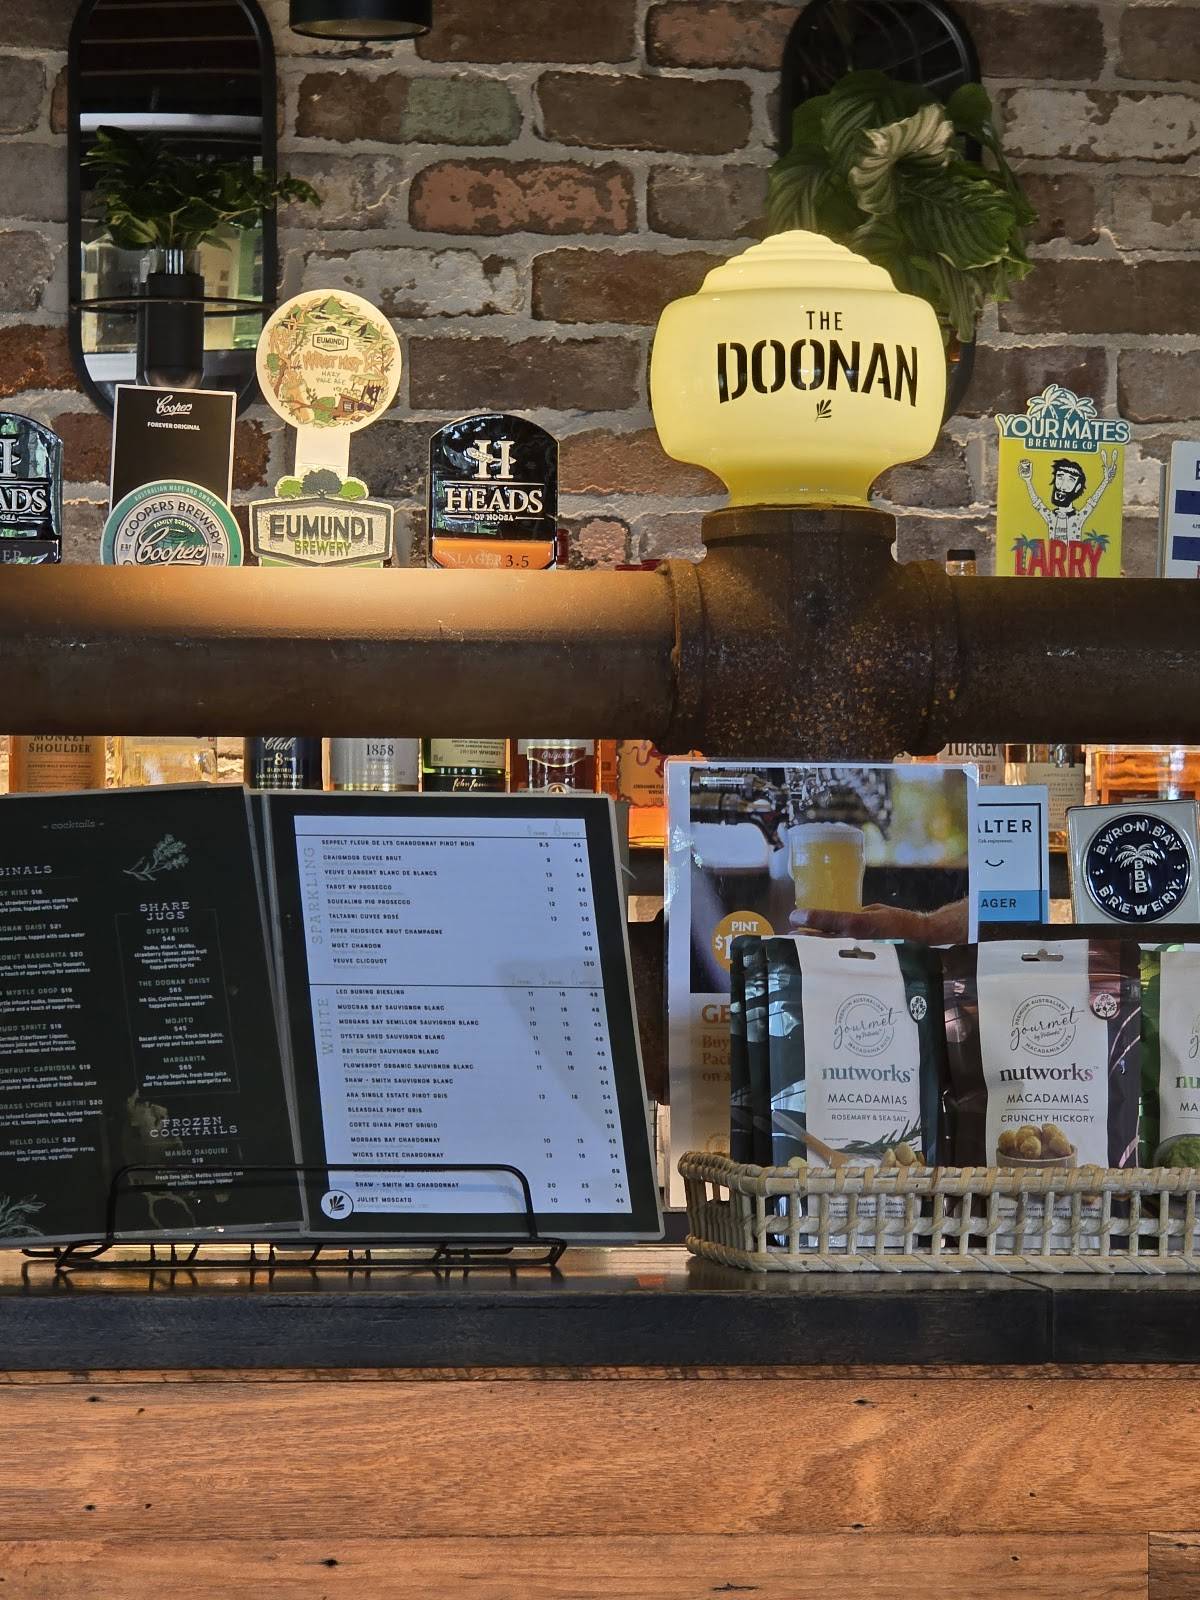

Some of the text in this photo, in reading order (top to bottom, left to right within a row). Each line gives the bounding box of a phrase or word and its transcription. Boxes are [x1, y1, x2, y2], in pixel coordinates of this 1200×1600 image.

[805, 310, 844, 331] THE
[316, 336, 345, 346] EUMUNDI
[717, 338, 918, 407] DOONAN
[156, 394, 193, 416] Coopers
[147, 421, 201, 431] FOREVER ORIGINAL
[999, 414, 1129, 442] YOUR MATES
[1027, 438, 1079, 449] BREWING
[169, 485, 185, 493] MADE
[185, 487, 198, 496] AND
[444, 487, 543, 513] HEADS
[125, 500, 223, 546] COOPERS BREWERY
[486, 514, 514, 522] NOOSA
[153, 518, 196, 533] FAMILY BREWED
[269, 513, 374, 545] EUMUNDI
[136, 526, 208, 566] Coopers
[294, 540, 352, 557] BREWERY
[505, 554, 530, 569] 3.5
[1014, 539, 1107, 578] LARRY
[28, 742, 91, 753] SHOULDER
[366, 743, 394, 756] 1858
[948, 742, 998, 757] TURKEY
[274, 752, 284, 766] 8
[50, 819, 96, 830] cocktails
[978, 819, 1032, 833] LTER
[1096, 819, 1182, 856] BYRON BAY
[304, 847, 323, 945] SPARKLING
[1098, 878, 1184, 916] BREWERY
[139, 901, 190, 912] SHARE
[981, 898, 1017, 909] AGER
[146, 911, 186, 921] JUGS
[731, 921, 759, 932] PINT
[24, 952, 67, 960] MARGARITA
[155, 978, 186, 986] DOONAN
[1015, 998, 1066, 1026] PREMIUM AUSTRALIAN
[164, 1016, 194, 1024] MOJITO
[317, 997, 334, 1056] WHITE
[833, 1007, 904, 1050] gourmet
[1009, 1006, 1085, 1051] gourmet
[1025, 1042, 1060, 1054] MACADAMIA
[163, 1056, 206, 1064] MARGARITA
[822, 1063, 911, 1083] nutworks
[1000, 1062, 1094, 1082] nutworks
[827, 1093, 908, 1106] MACADAMIAS
[1006, 1093, 1090, 1104] MACADAMIAS
[161, 1116, 222, 1128] FROZEN
[878, 1114, 892, 1122] SEA
[892, 1114, 907, 1122] SALT
[1000, 1114, 1095, 1123] CRUNCHY HICKORY
[149, 1125, 238, 1138] COCKTAILS
[10, 1138, 33, 1146] HELLO
